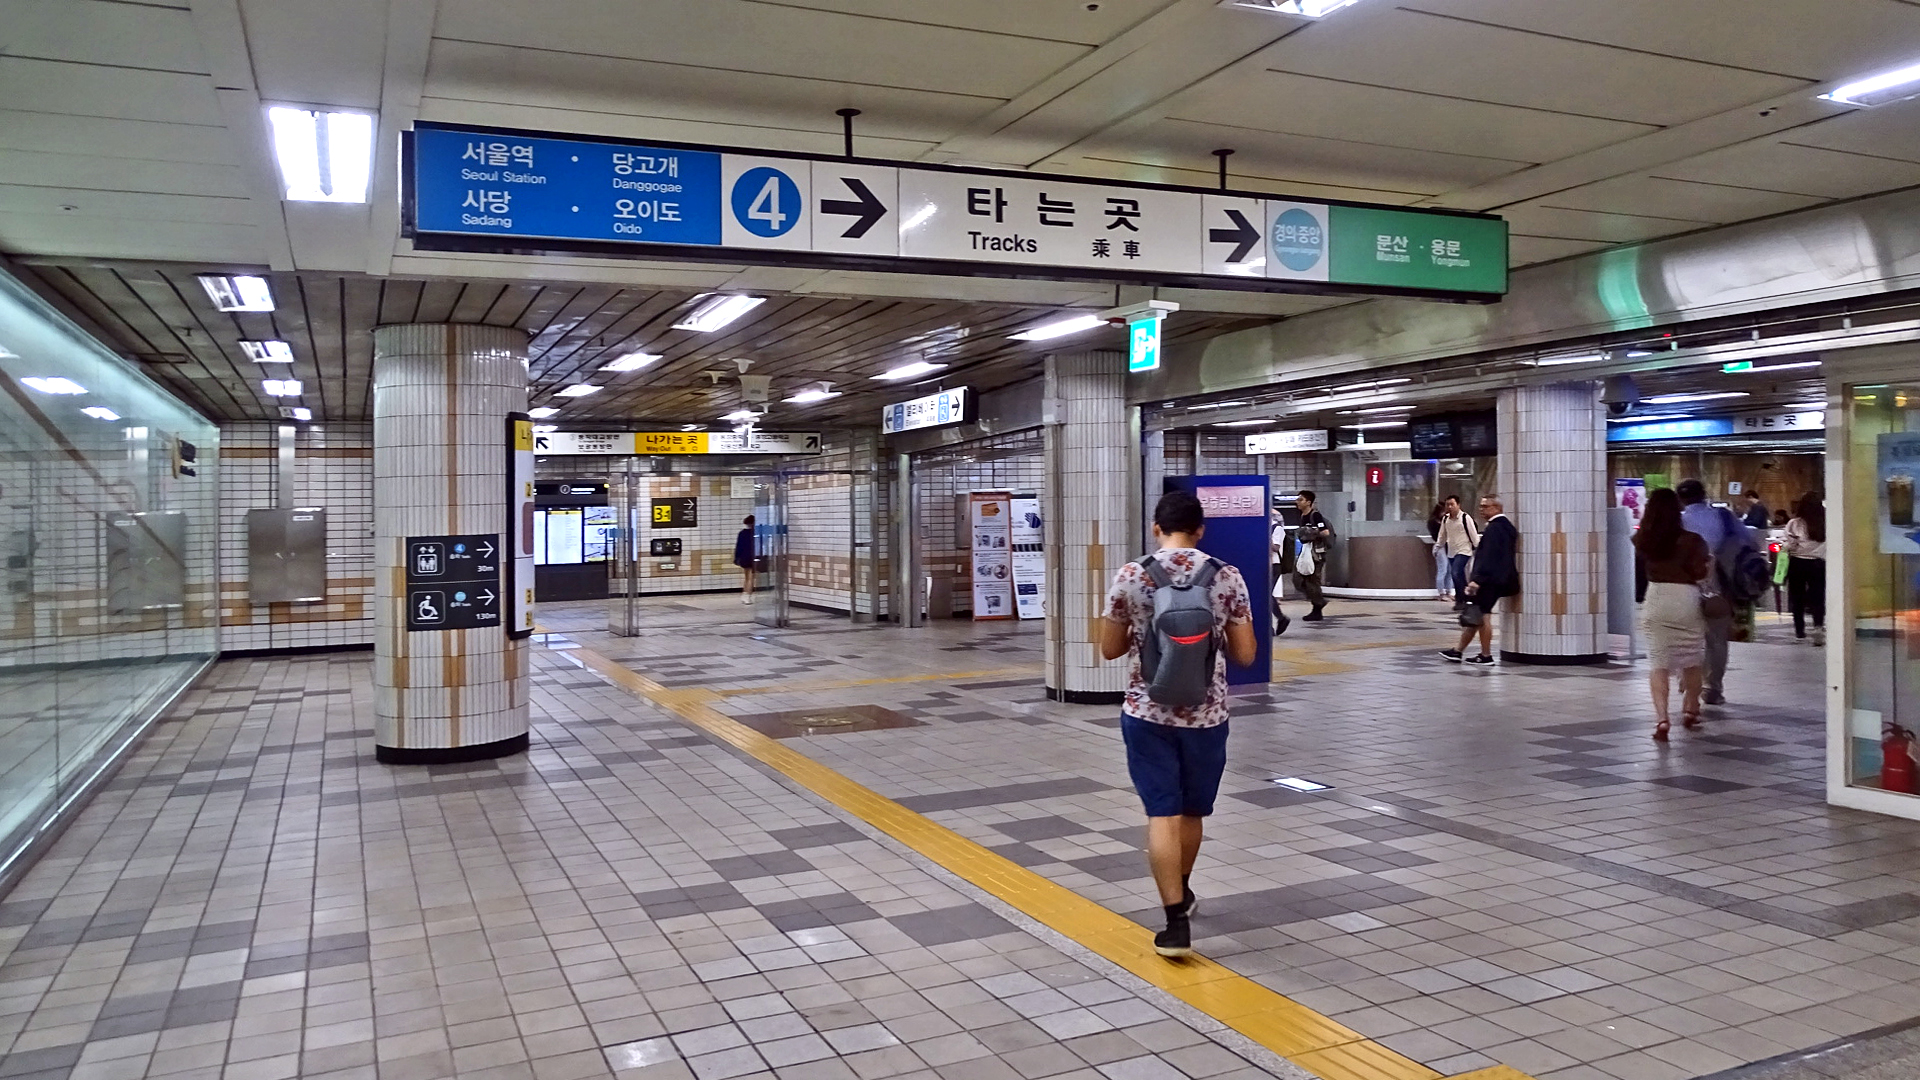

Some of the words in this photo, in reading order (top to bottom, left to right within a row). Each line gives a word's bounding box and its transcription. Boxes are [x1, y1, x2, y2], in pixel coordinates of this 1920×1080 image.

[462, 142, 534, 168] 서울역
[612, 152, 679, 178] 당고개
[461, 169, 499, 182] Seoul
[503, 171, 546, 184] Station
[612, 178, 683, 193] Danggogae
[462, 189, 512, 214] 사당
[613, 199, 682, 223] 오이도
[747, 176, 786, 231] 4
[461, 214, 512, 229] Sadang
[1104, 197, 1142, 233] 곳
[613, 223, 643, 235] Oido
[968, 231, 1038, 254] Tracks
[1377, 235, 1409, 253] 문산
[1431, 239, 1461, 257] 용문
[646, 435, 683, 445] 나가는
[687, 435, 698, 446] 곳
[477, 565, 495, 573] 30m
